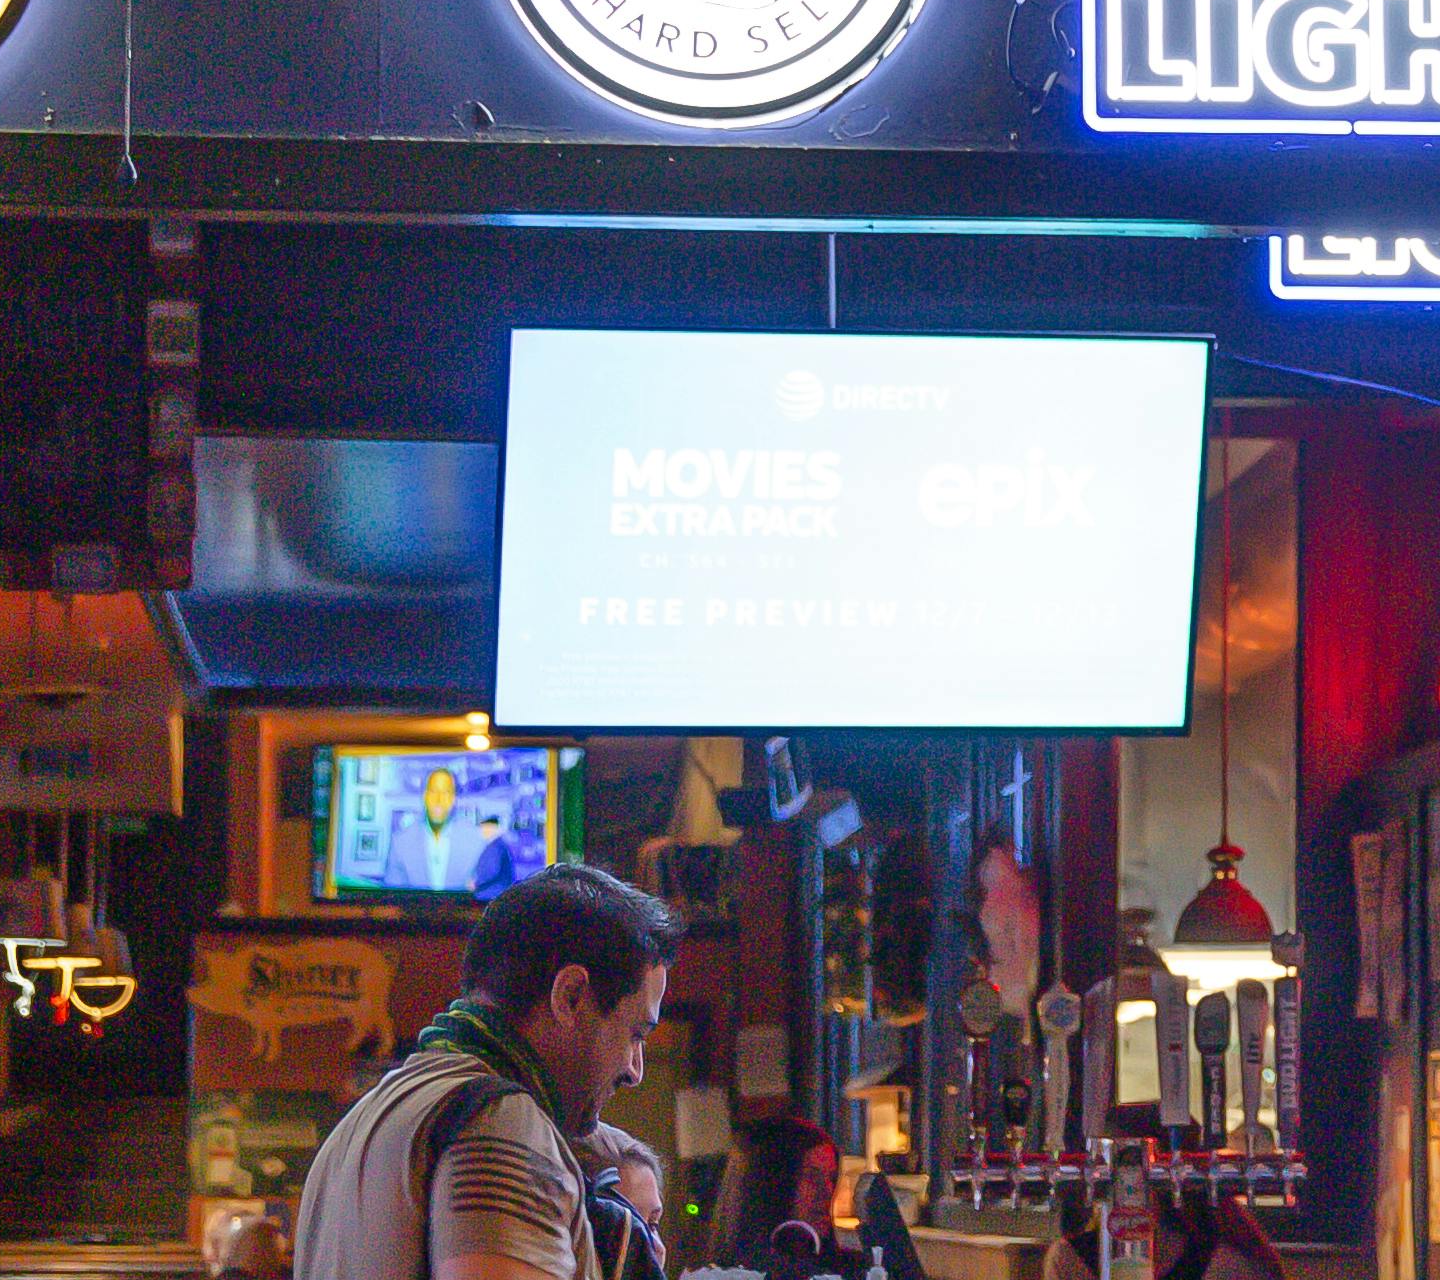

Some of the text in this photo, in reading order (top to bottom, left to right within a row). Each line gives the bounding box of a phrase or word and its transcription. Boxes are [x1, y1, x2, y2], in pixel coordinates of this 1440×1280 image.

[832, 383, 951, 413] DIRECTV
[611, 446, 843, 501] MOVIES
[609, 503, 841, 539] EXTRA PACK
[578, 596, 687, 627] FREE
[705, 596, 900, 627] PREVIEW
